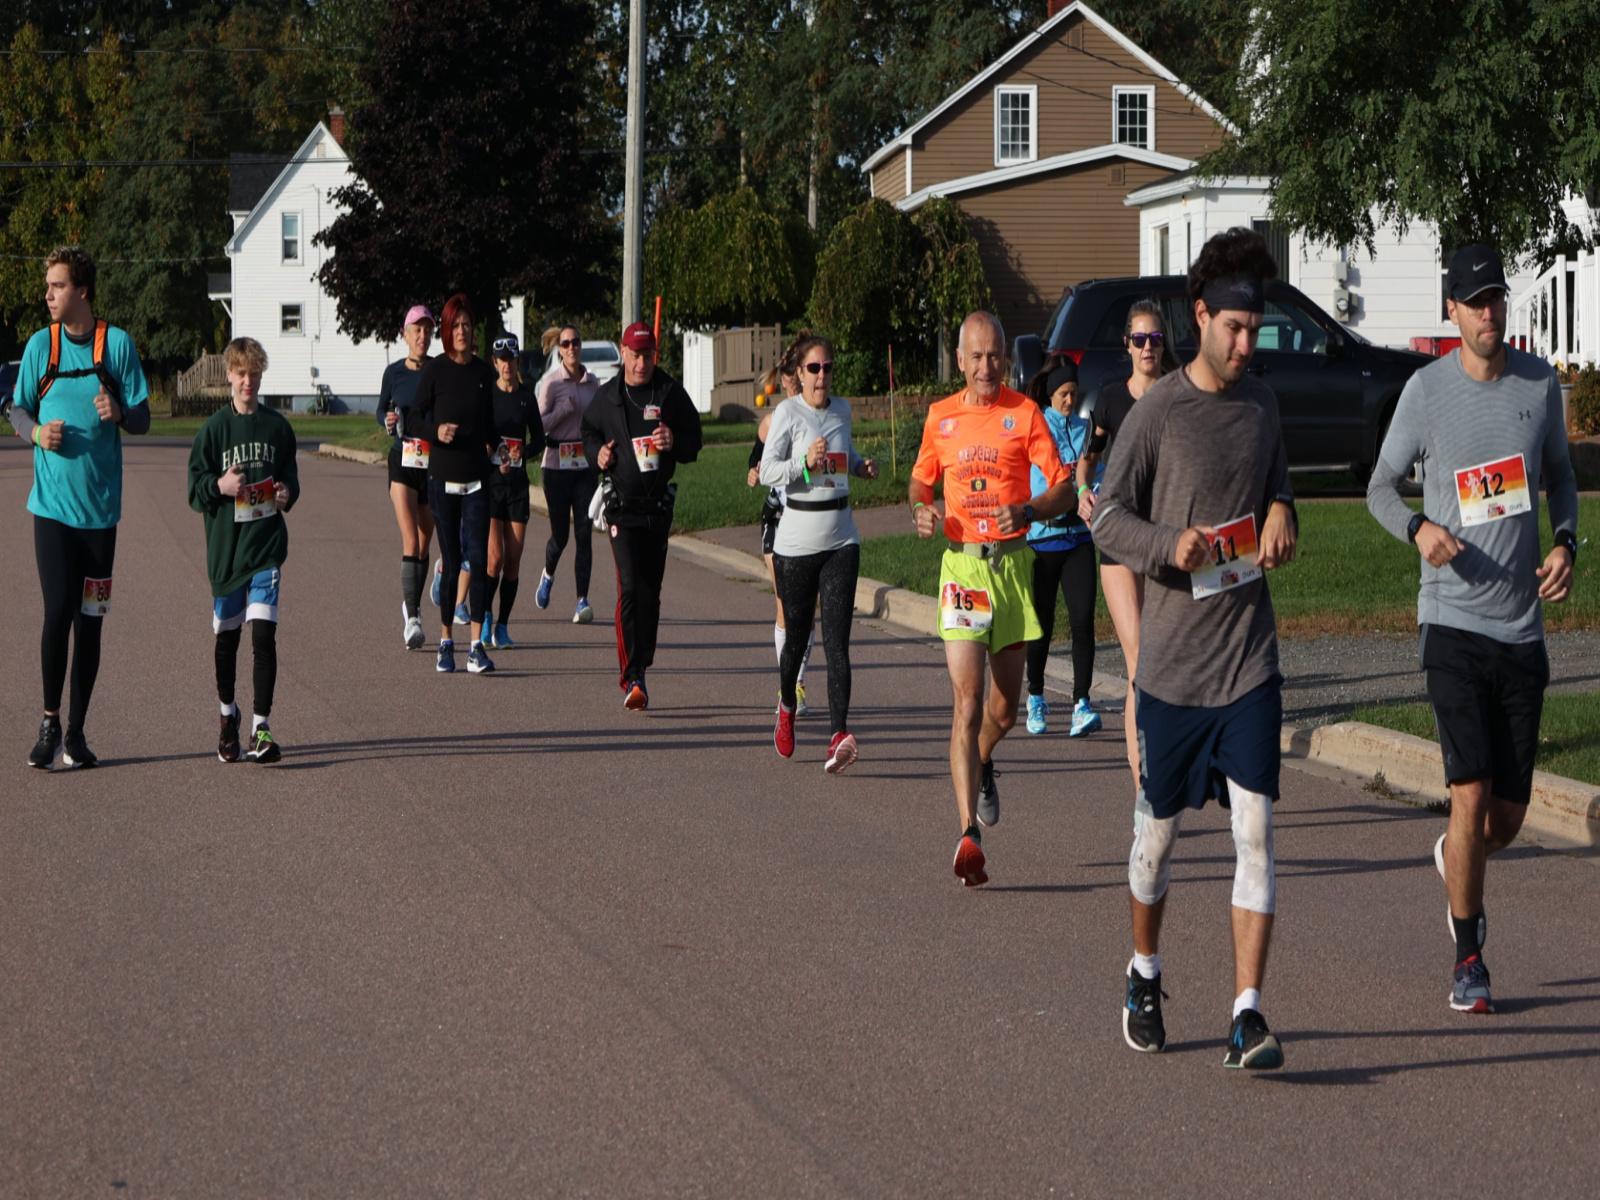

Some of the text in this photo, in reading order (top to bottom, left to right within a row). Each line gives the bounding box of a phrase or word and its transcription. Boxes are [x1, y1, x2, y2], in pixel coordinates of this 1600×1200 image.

[416, 444, 423, 457] 5
[643, 443, 650, 458] 7
[823, 458, 837, 475] 13
[1480, 472, 1506, 500] 12
[1214, 535, 1240, 567] 11
[954, 592, 974, 611] 15
